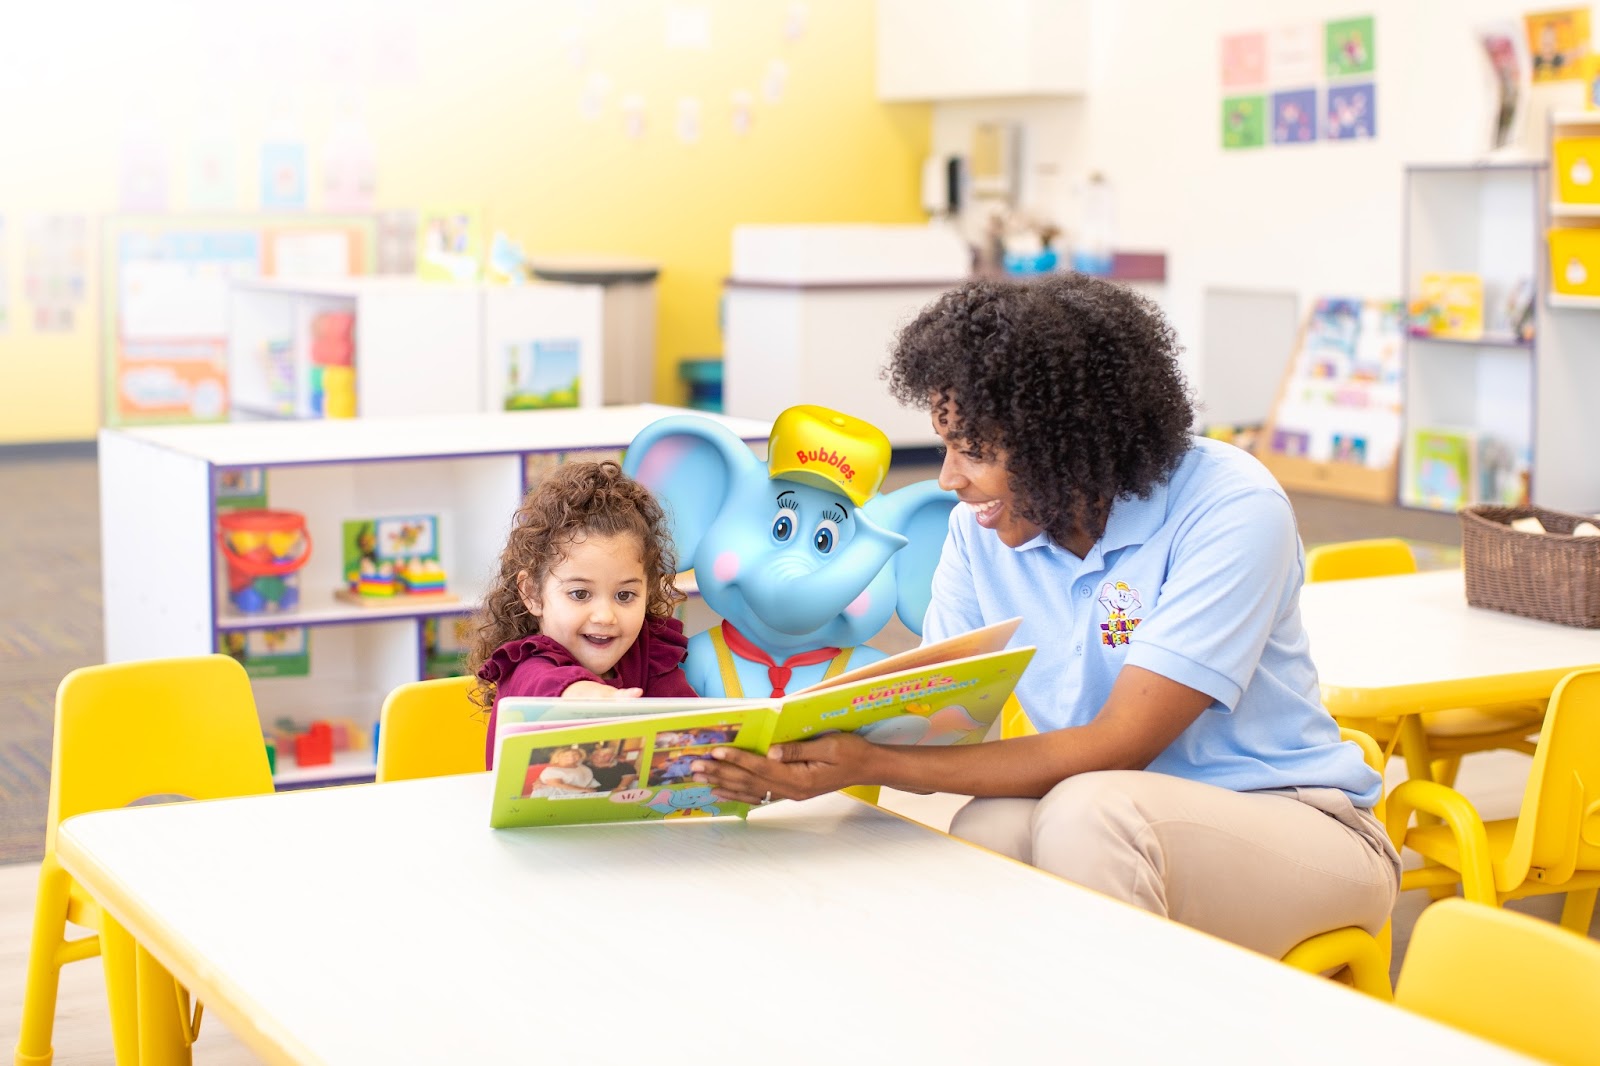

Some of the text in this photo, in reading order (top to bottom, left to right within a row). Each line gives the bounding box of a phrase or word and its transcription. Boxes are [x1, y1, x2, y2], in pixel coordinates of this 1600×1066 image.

[797, 447, 855, 479] Bubbles
[821, 708, 848, 720] THE
[900, 678, 979, 700] ELEPHANT
[852, 677, 953, 704] BUBBLES
